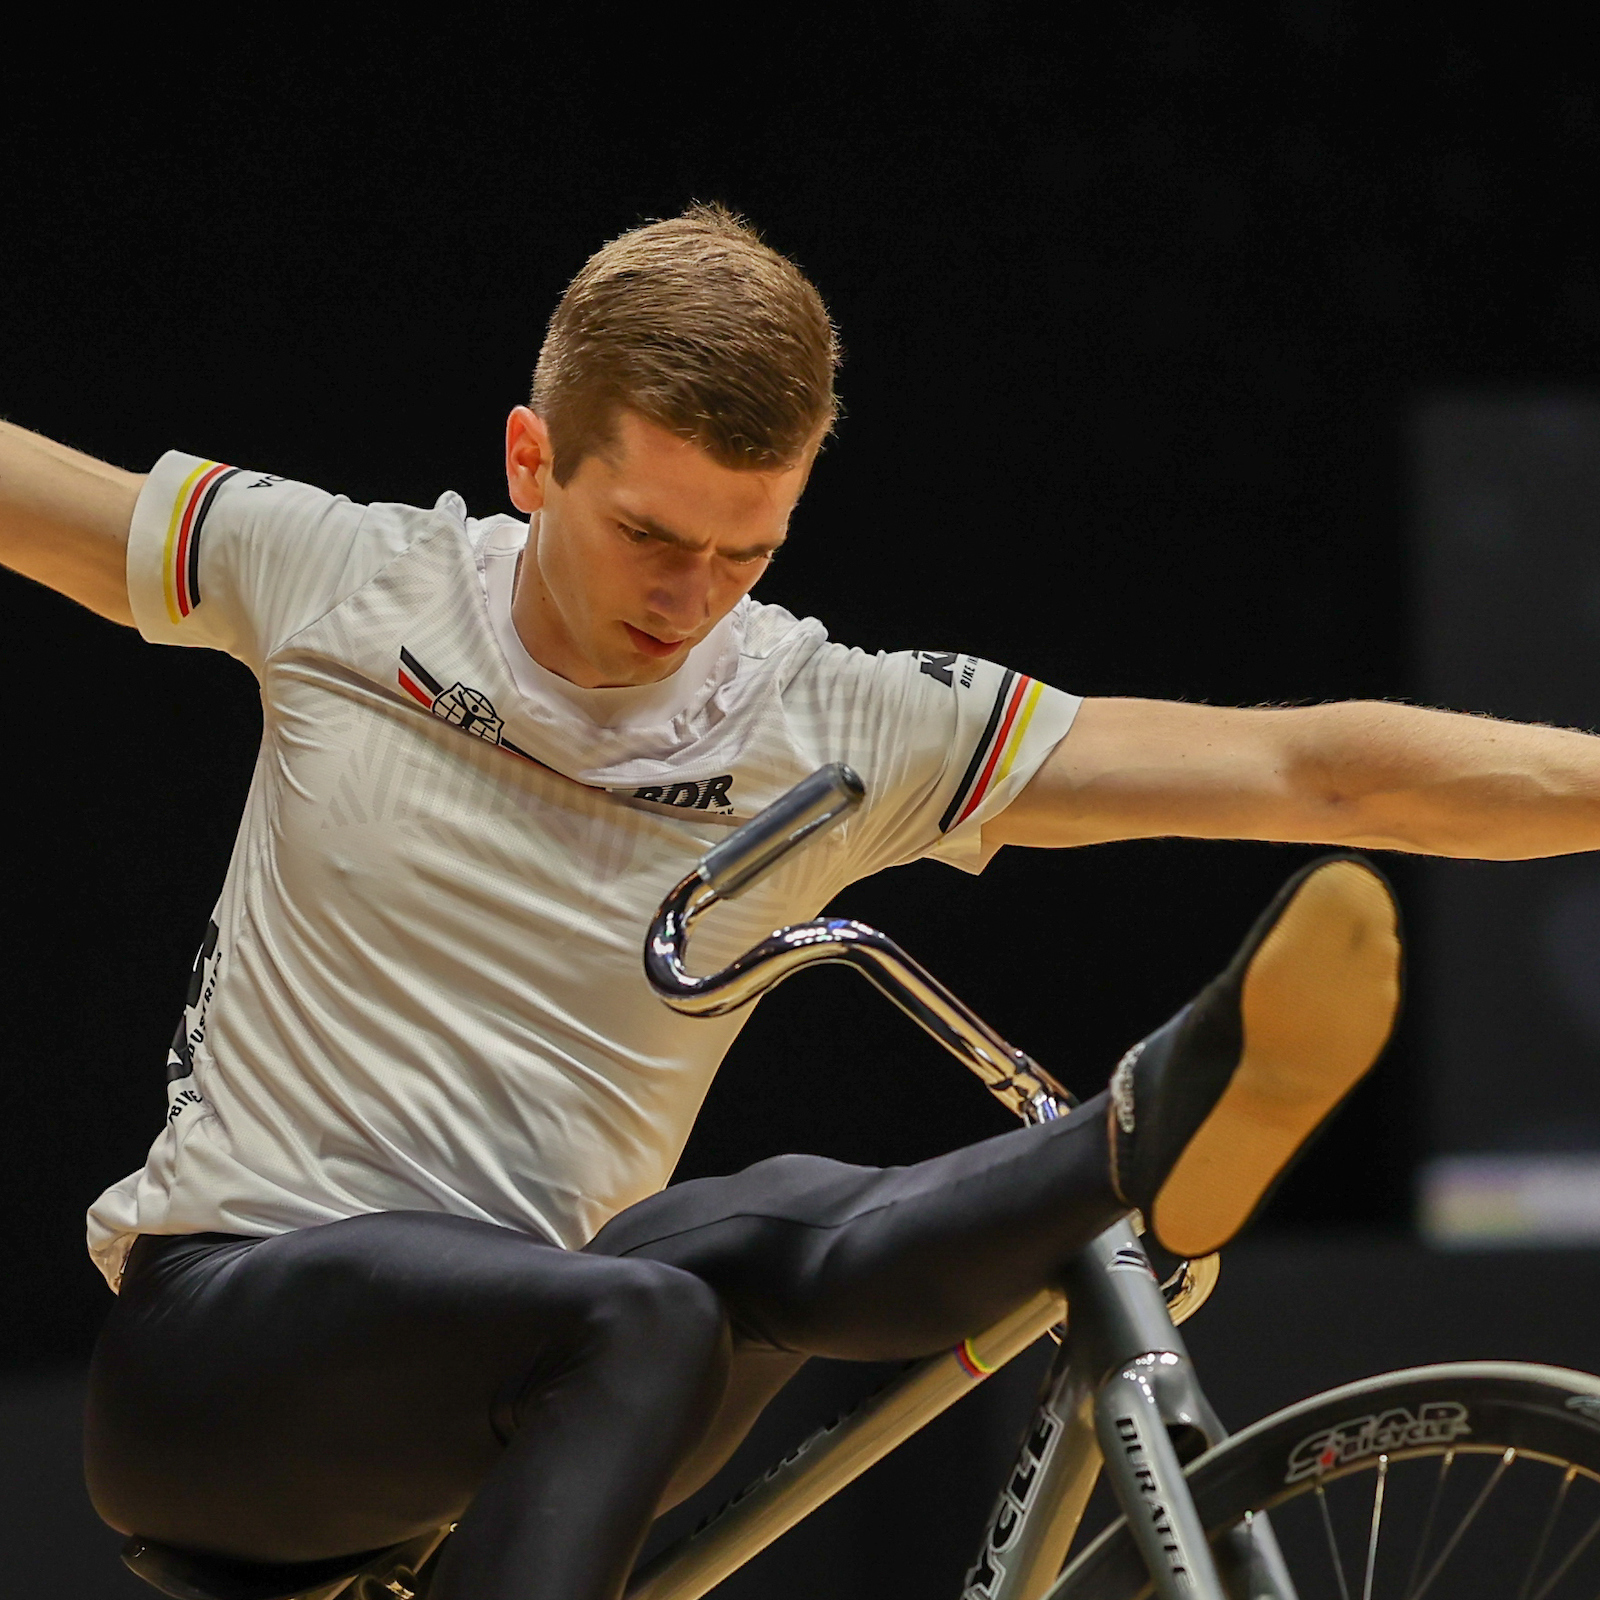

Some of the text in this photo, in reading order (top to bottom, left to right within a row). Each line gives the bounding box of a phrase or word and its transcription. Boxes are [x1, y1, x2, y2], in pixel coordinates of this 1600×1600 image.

[959, 664, 977, 690] BIKE
[632, 773, 735, 810] BDR
[1284, 1401, 1473, 1485] STAR
